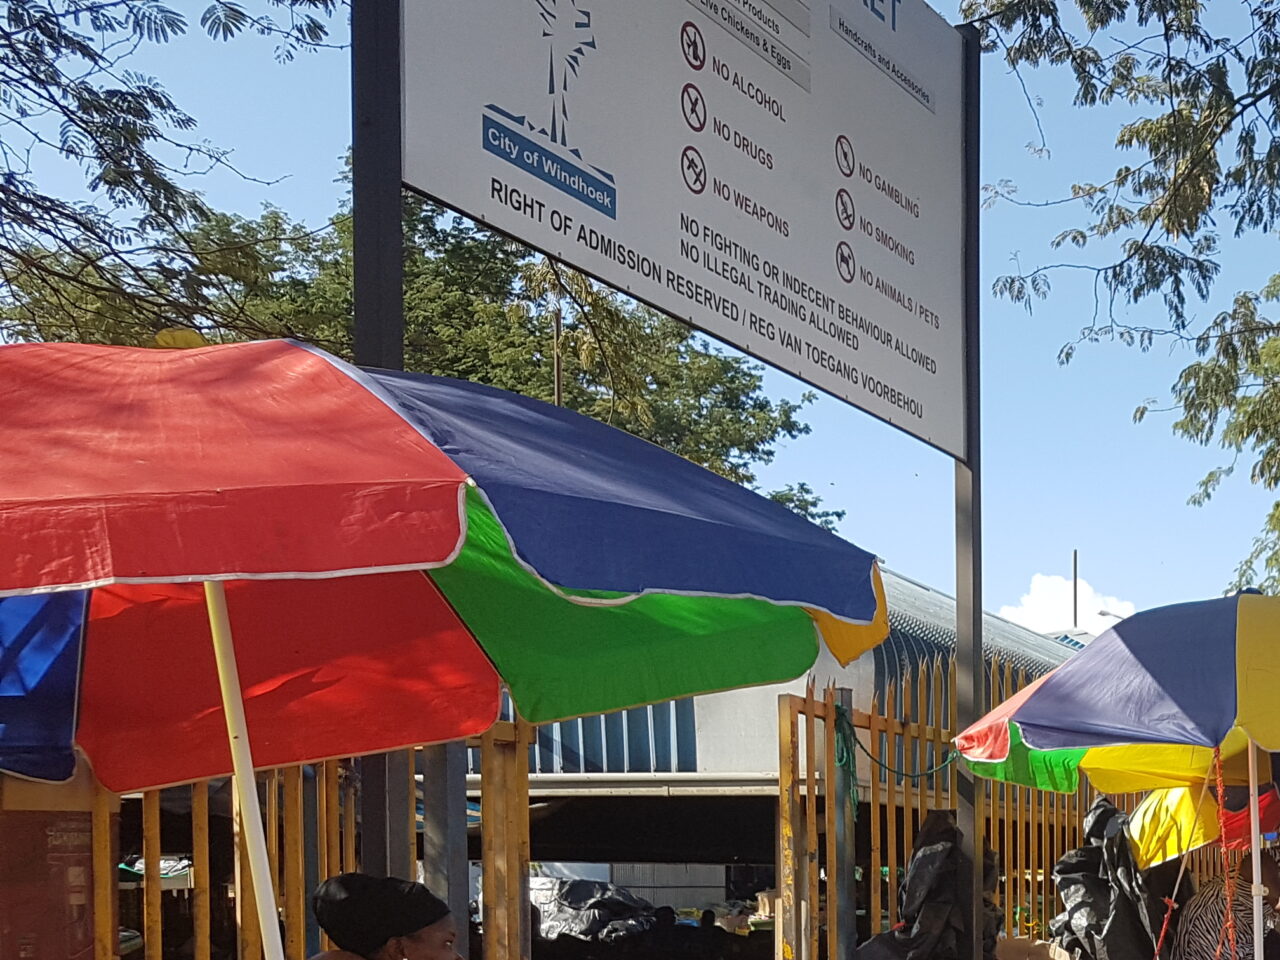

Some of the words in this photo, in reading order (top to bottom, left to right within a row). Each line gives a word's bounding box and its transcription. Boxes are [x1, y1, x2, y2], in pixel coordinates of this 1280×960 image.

[721, 7, 760, 47] Chickens
[762, 39, 769, 53] &
[770, 45, 791, 71] Eggs
[838, 18, 877, 59] Handcrafts
[878, 54, 891, 71] and
[891, 64, 930, 104] Accessories
[712, 56, 730, 81] NO
[732, 72, 786, 123] ALCOHOL
[488, 128, 519, 159] City
[523, 149, 539, 168] of
[542, 155, 612, 209] Windhoek
[713, 116, 731, 142] NO
[733, 131, 774, 170] DRUGS
[713, 177, 731, 202] NO
[733, 192, 790, 238] WEAPONS
[858, 162, 873, 184] NO
[874, 175, 920, 218] GAMBLING
[859, 215, 873, 237] NO
[875, 226, 915, 266] SMOKING
[491, 177, 546, 224] RIGHT
[550, 209, 574, 236] OF
[577, 224, 662, 285] ADMISSION
[666, 269, 739, 323] RESERVED
[750, 313, 775, 342] REG
[778, 327, 802, 356] VAN
[805, 341, 859, 385] TOEGANG
[861, 371, 923, 420] VOORBEHOU
[680, 212, 700, 238] NO
[703, 225, 760, 272] FIGHTING
[762, 260, 779, 284] OR
[782, 270, 835, 313] INDECENT
[838, 304, 893, 347] BEHAVIOUR
[894, 338, 937, 375] ALLOWED
[680, 238, 700, 264] NO
[703, 251, 754, 294] ILLEGAL
[757, 280, 807, 322] TRADING
[808, 311, 860, 352] ALLOWED
[859, 265, 873, 287] NO
[874, 276, 913, 313] ANIMALS
[918, 306, 940, 330] PETS
